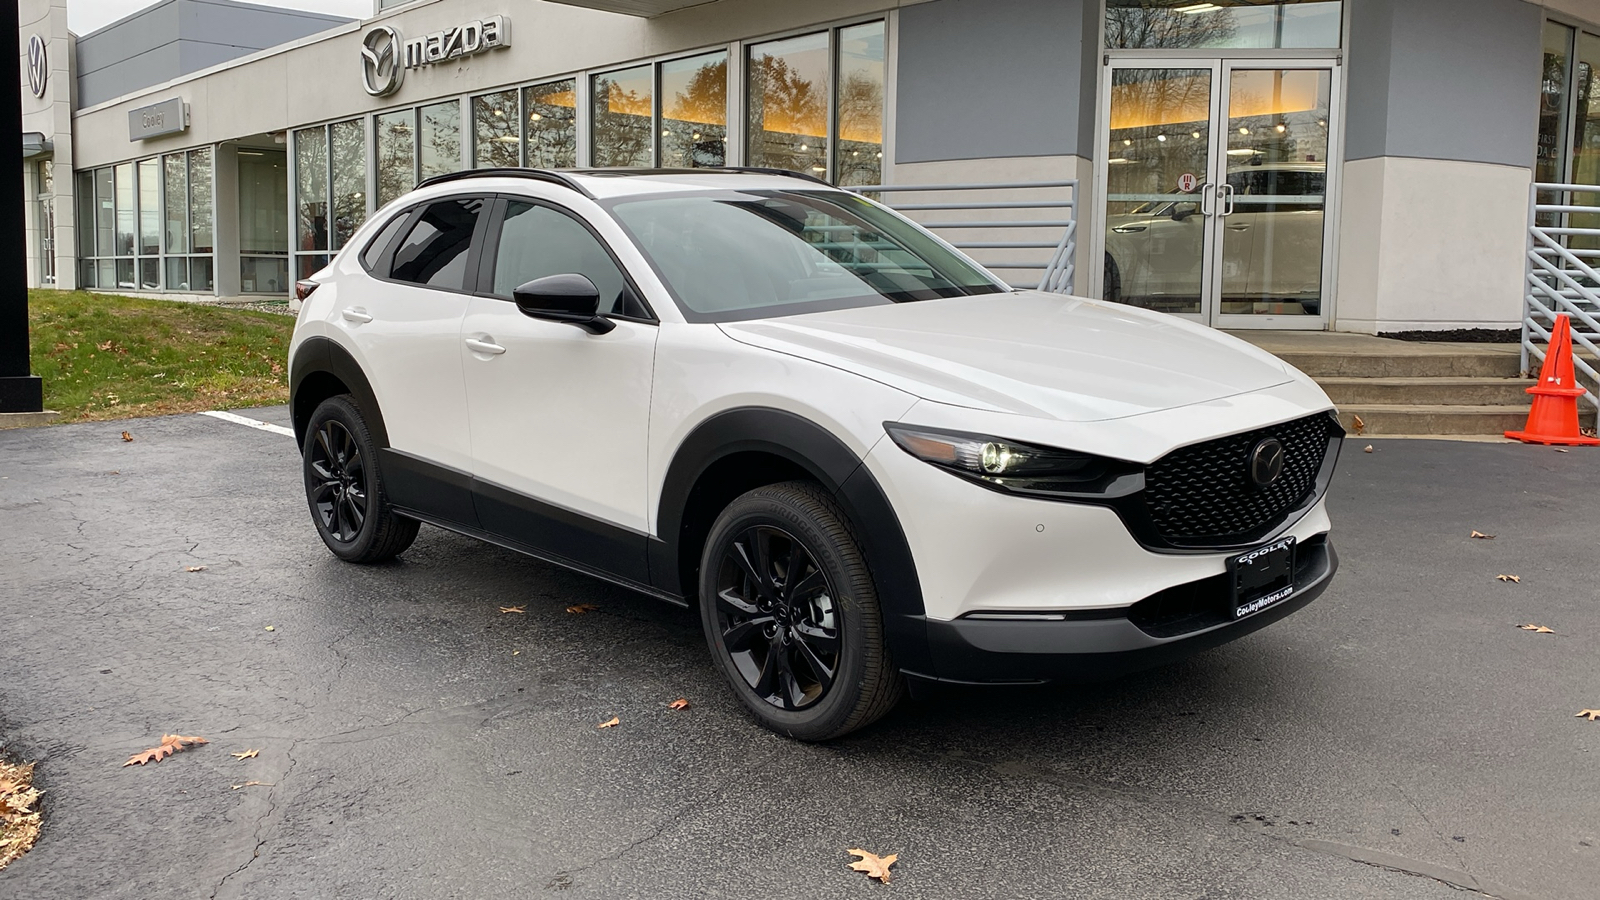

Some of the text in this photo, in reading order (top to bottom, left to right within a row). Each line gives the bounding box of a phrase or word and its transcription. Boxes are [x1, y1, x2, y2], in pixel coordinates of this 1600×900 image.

[142, 106, 165, 130] Cooley
[1184, 182, 1190, 190] R
[1238, 537, 1294, 563] COOLEY
[1236, 587, 1293, 617] CooleyMotors.com
